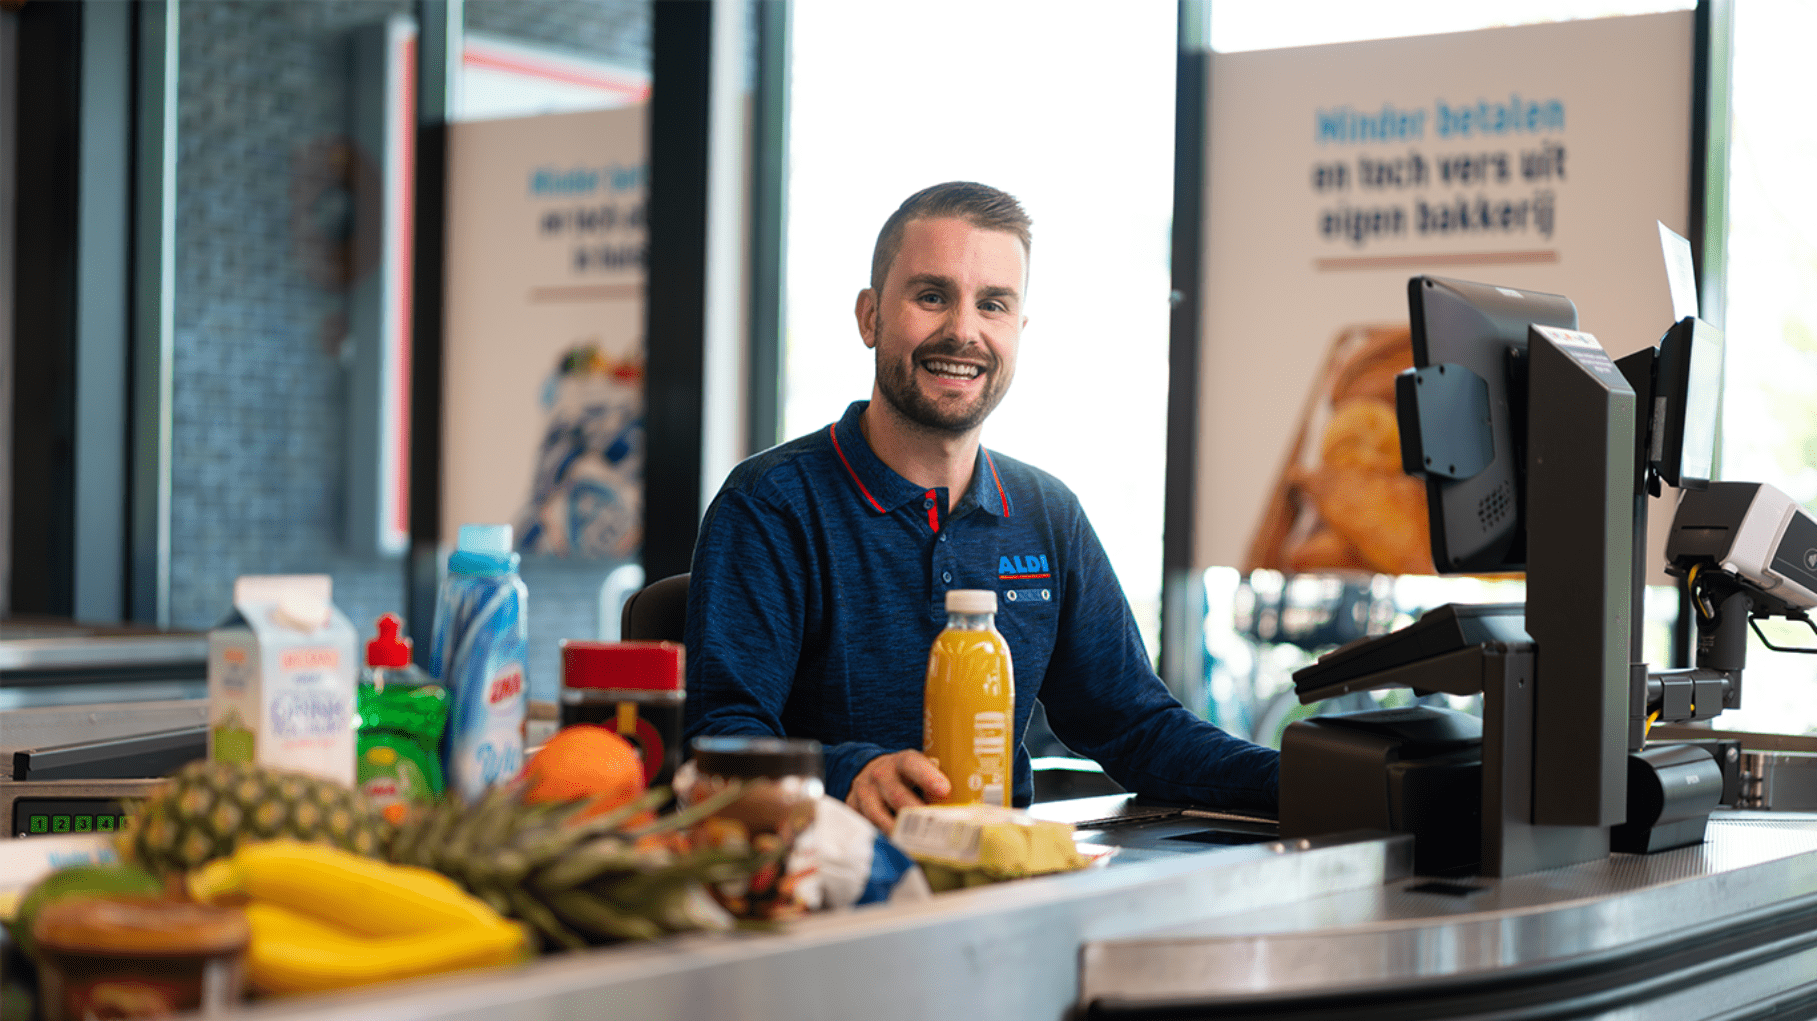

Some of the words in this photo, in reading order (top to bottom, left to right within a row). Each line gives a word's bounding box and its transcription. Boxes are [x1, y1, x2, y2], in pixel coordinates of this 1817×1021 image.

[1315, 105, 1424, 143] Minder
[1434, 97, 1564, 138] betalen
[1312, 161, 1350, 192] en
[1357, 149, 1429, 190] toch
[1437, 153, 1511, 187] vers
[1518, 140, 1566, 183] uit
[1319, 202, 1406, 247] eigen
[1415, 191, 1555, 240] bakkerij
[999, 554, 1049, 574] ALDI
